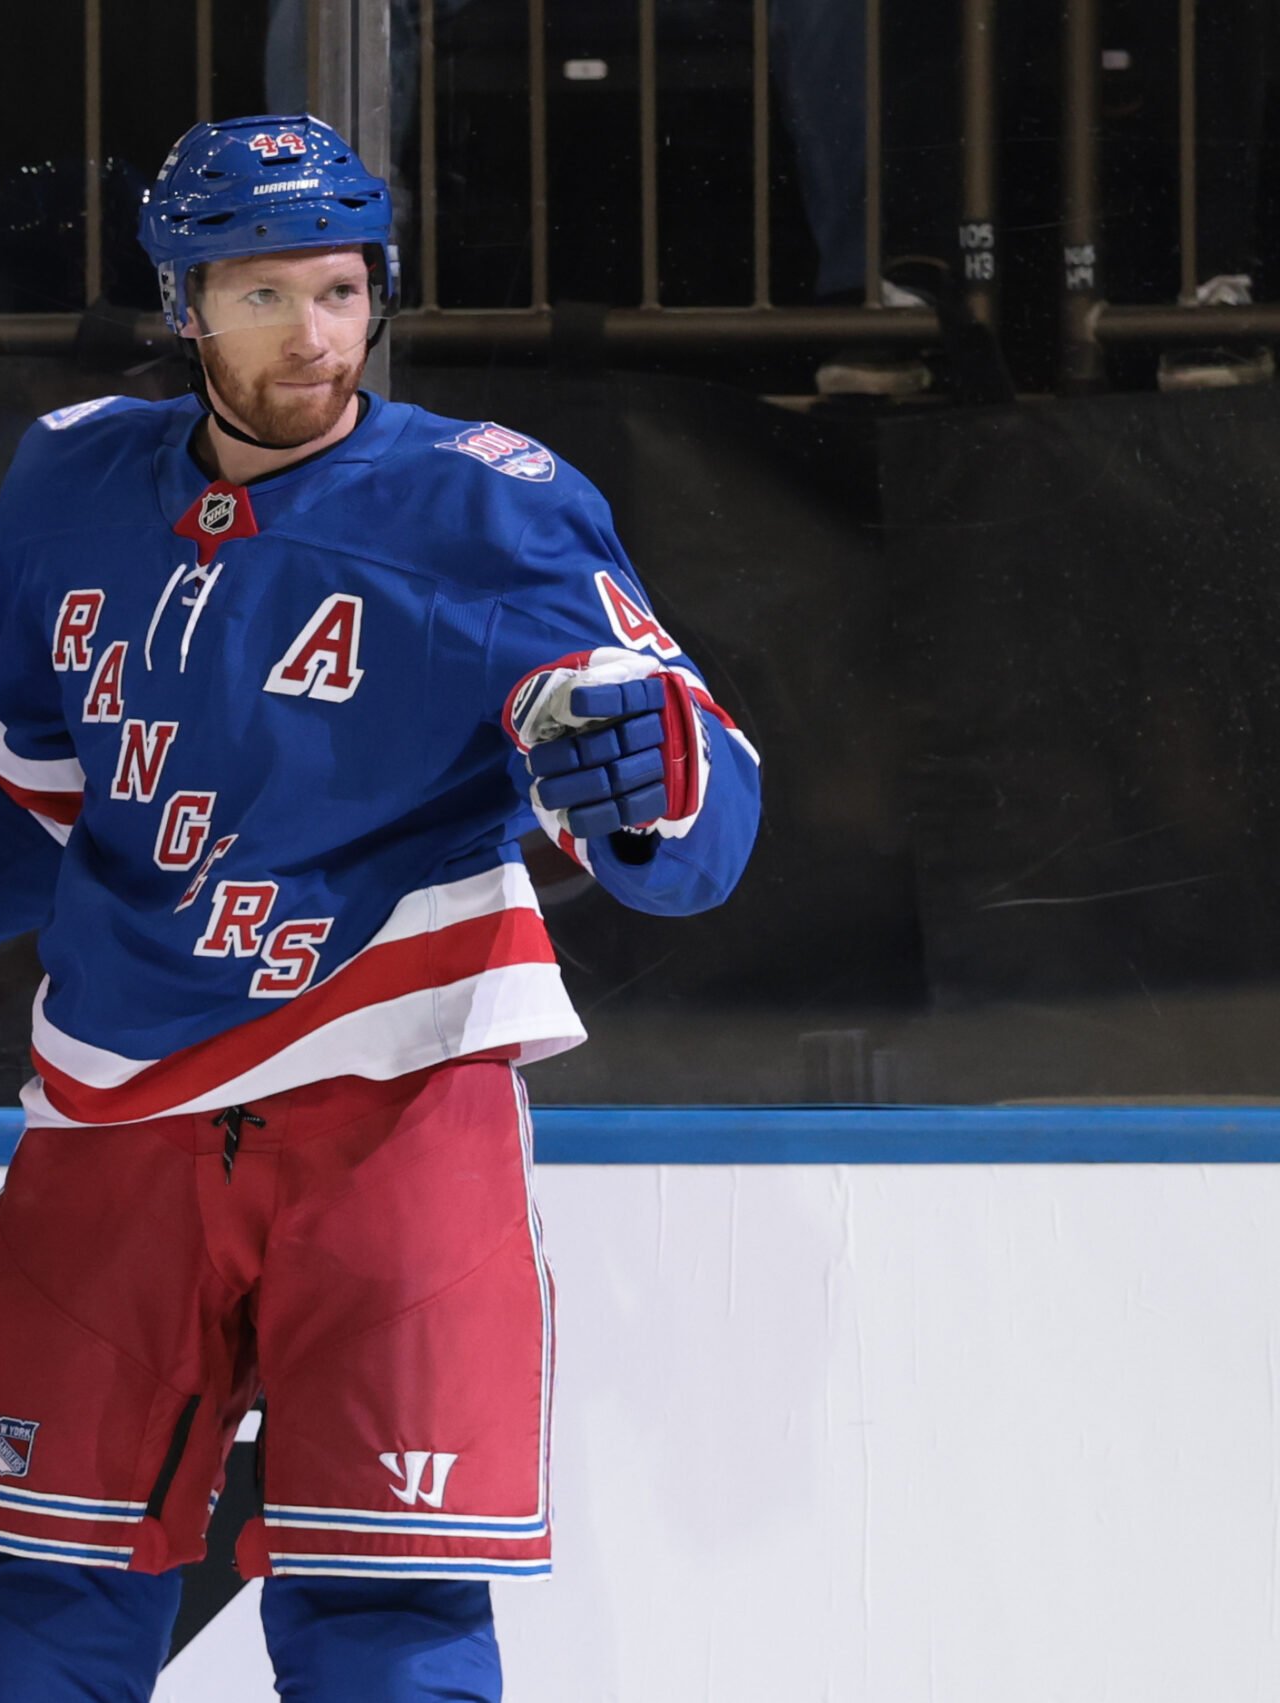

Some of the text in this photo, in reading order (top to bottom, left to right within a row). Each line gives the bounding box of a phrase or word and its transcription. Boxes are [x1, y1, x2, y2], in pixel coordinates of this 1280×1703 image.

[248, 132, 307, 158] 44
[253, 178, 319, 196] WARRIOR
[959, 223, 995, 249] 105
[206, 503, 230, 525] NHL
[263, 593, 364, 702] A
